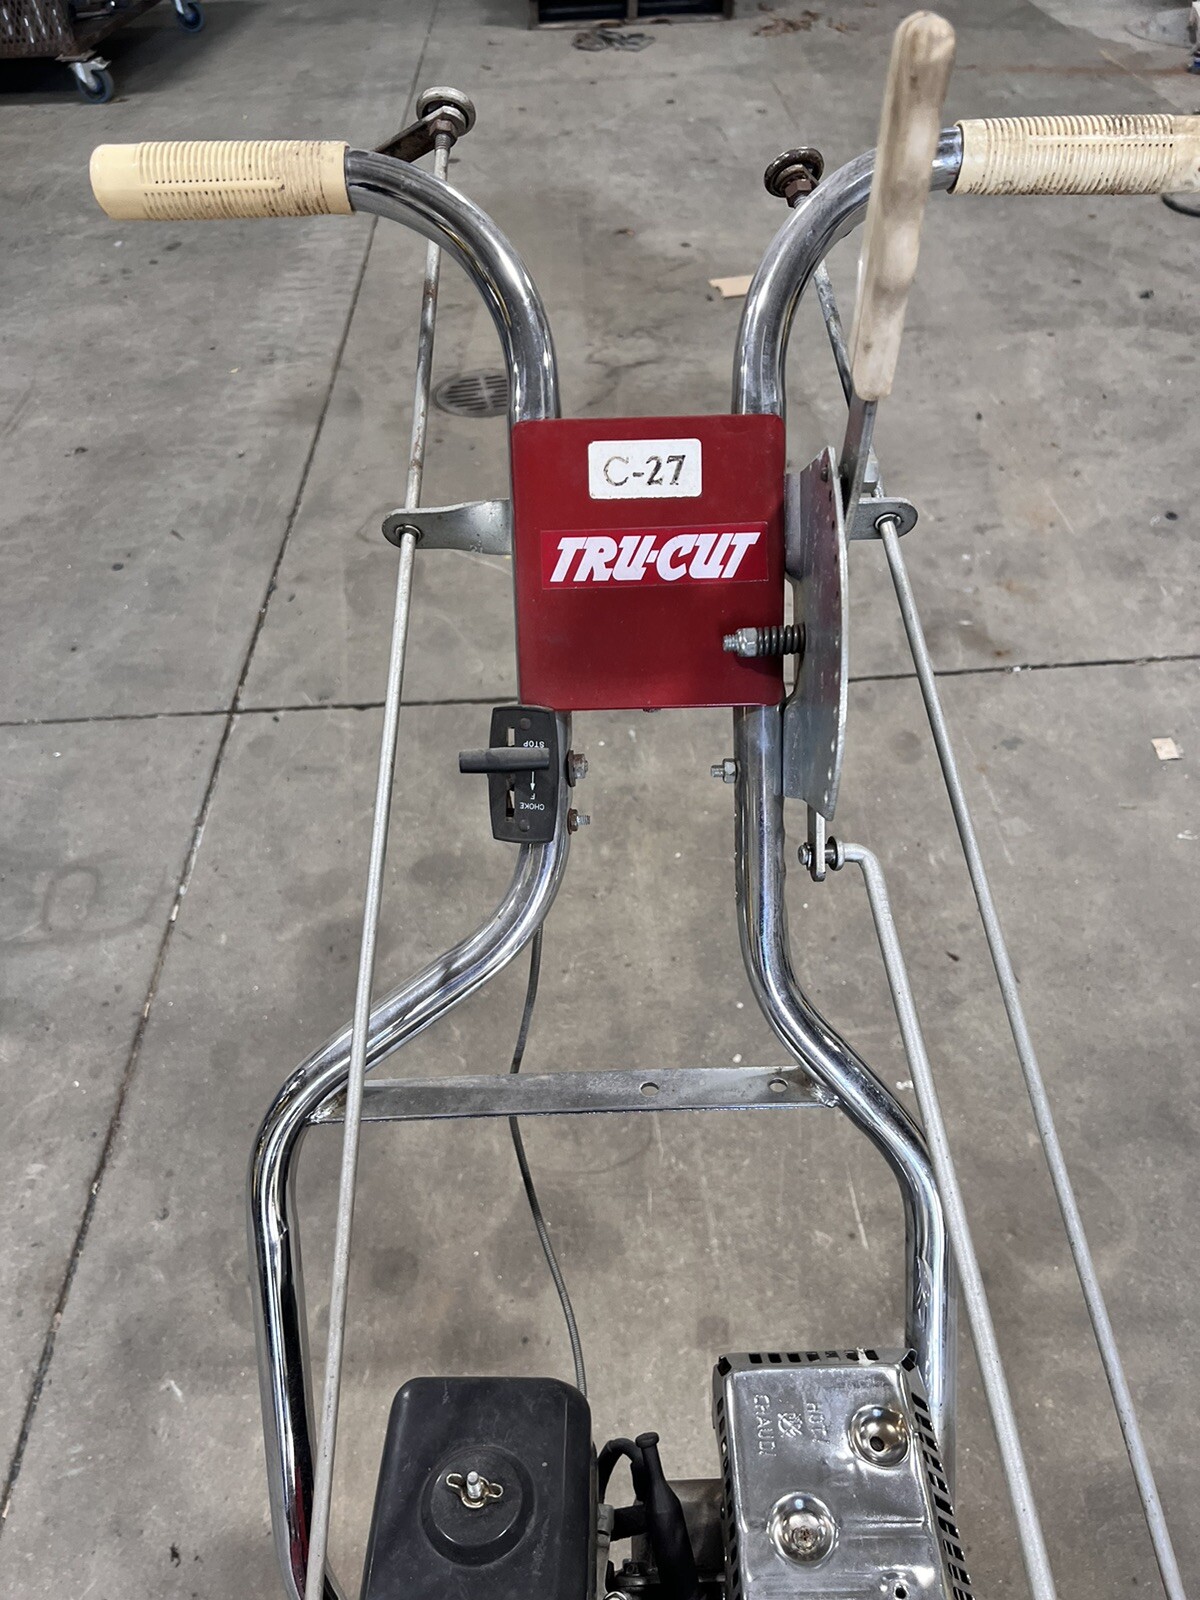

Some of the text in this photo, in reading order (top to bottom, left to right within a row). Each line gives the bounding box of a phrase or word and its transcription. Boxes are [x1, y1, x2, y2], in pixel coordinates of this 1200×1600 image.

[602, 454, 687, 487] C-27
[550, 531, 761, 583] TRU-CUT
[523, 740, 545, 748] STOP
[519, 802, 545, 811] CHOKE
